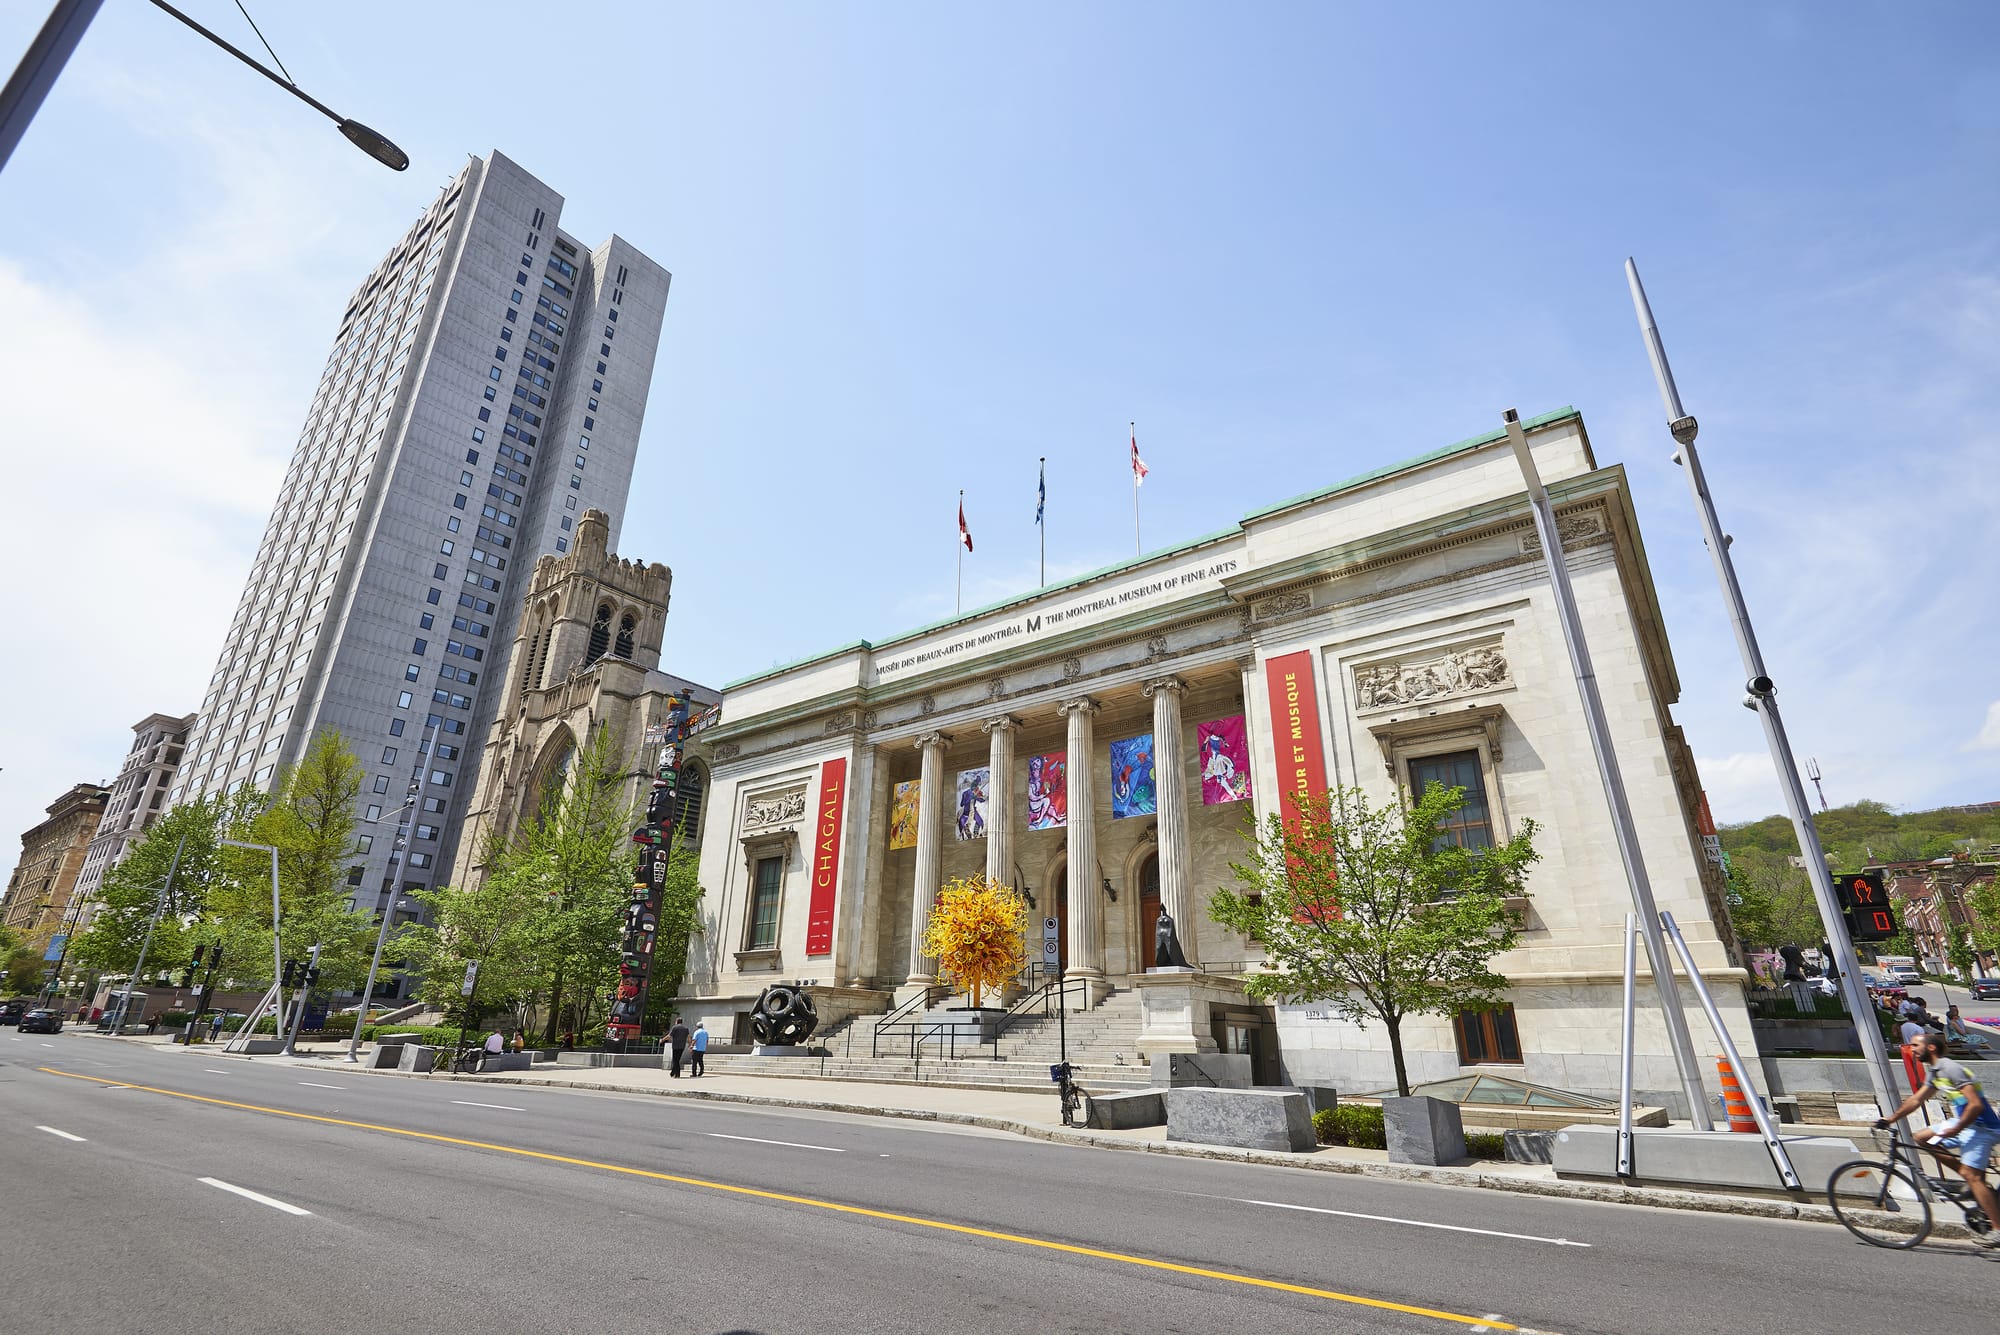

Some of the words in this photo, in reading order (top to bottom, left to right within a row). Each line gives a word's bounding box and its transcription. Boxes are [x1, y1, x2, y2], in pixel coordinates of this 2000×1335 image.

[875, 660, 900, 675] MUSÉE
[901, 657, 915, 668] DES
[916, 642, 964, 664] BEAUX-ARTS
[965, 638, 976, 649] DE
[977, 624, 1023, 645] MONTRÉAL
[1026, 615, 1042, 634] M
[1045, 612, 1064, 625] THE
[1066, 597, 1117, 621] MONTREAL
[1119, 582, 1162, 602] MUSEUM
[1164, 577, 1178, 589] OF
[1180, 569, 1205, 585] FINE
[1208, 560, 1237, 577] ARTS
[1286, 672, 1302, 739] MUSIQUE
[1293, 745, 1305, 763] ET
[818, 781, 839, 887] CHAGALL
